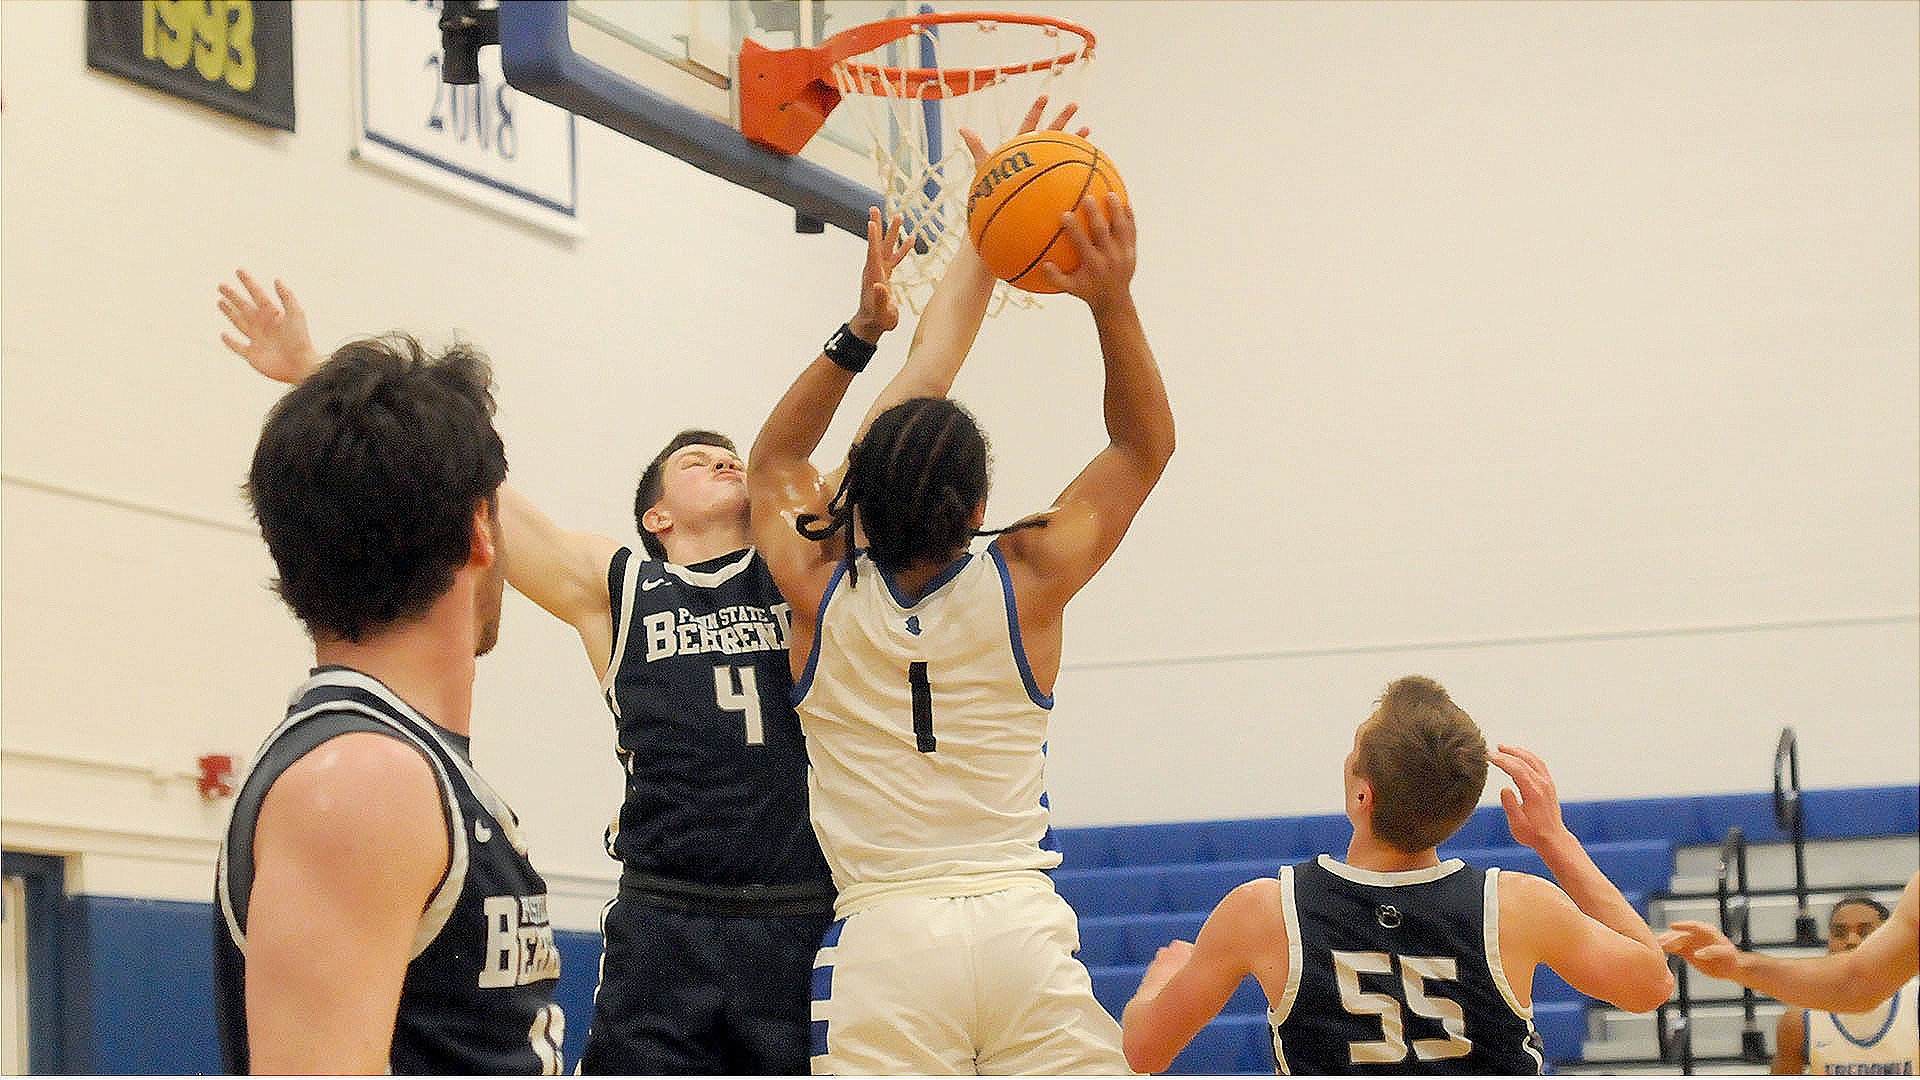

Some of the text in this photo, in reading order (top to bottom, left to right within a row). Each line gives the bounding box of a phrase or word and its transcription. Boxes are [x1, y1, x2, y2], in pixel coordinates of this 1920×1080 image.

[143, 1, 256, 91] 1993
[719, 605, 768, 626] STATE
[712, 664, 765, 746] 4
[908, 661, 937, 753] 1
[1331, 949, 1472, 1064] 55
